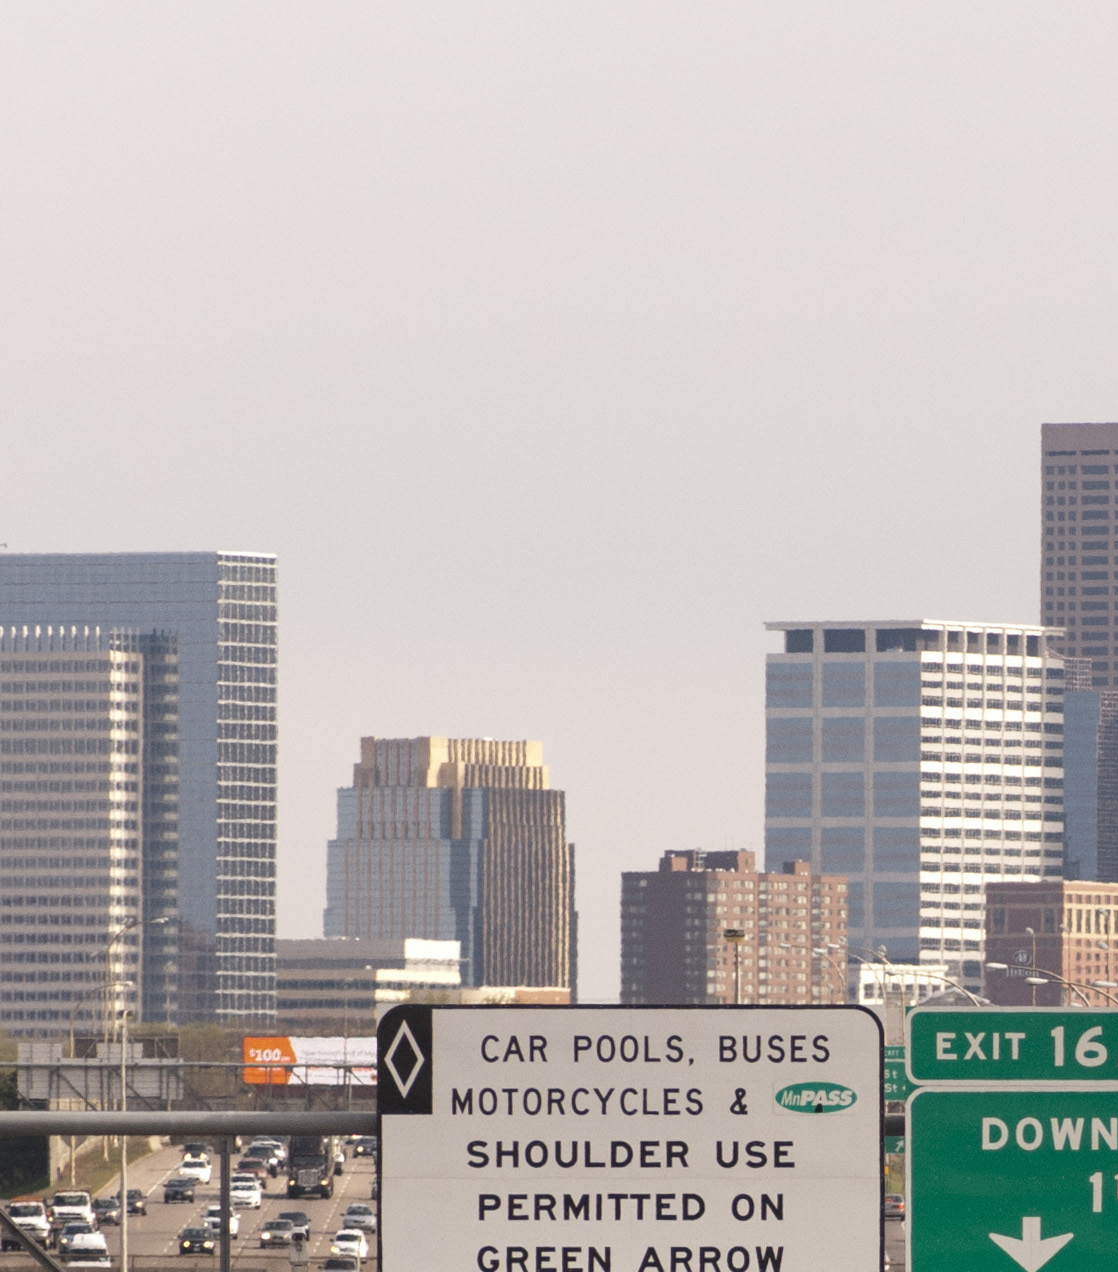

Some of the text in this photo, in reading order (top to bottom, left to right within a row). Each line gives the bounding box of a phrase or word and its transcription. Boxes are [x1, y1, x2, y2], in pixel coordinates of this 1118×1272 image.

[480, 1034, 831, 1067] CAR POOLS, BUSES
[936, 1031, 1026, 1061] EXIT
[451, 1087, 853, 1116] MOTORCYCLES & MnPASS
[466, 1139, 796, 1169] SHOULDER USE
[478, 1192, 785, 1222] PERMITTED ON
